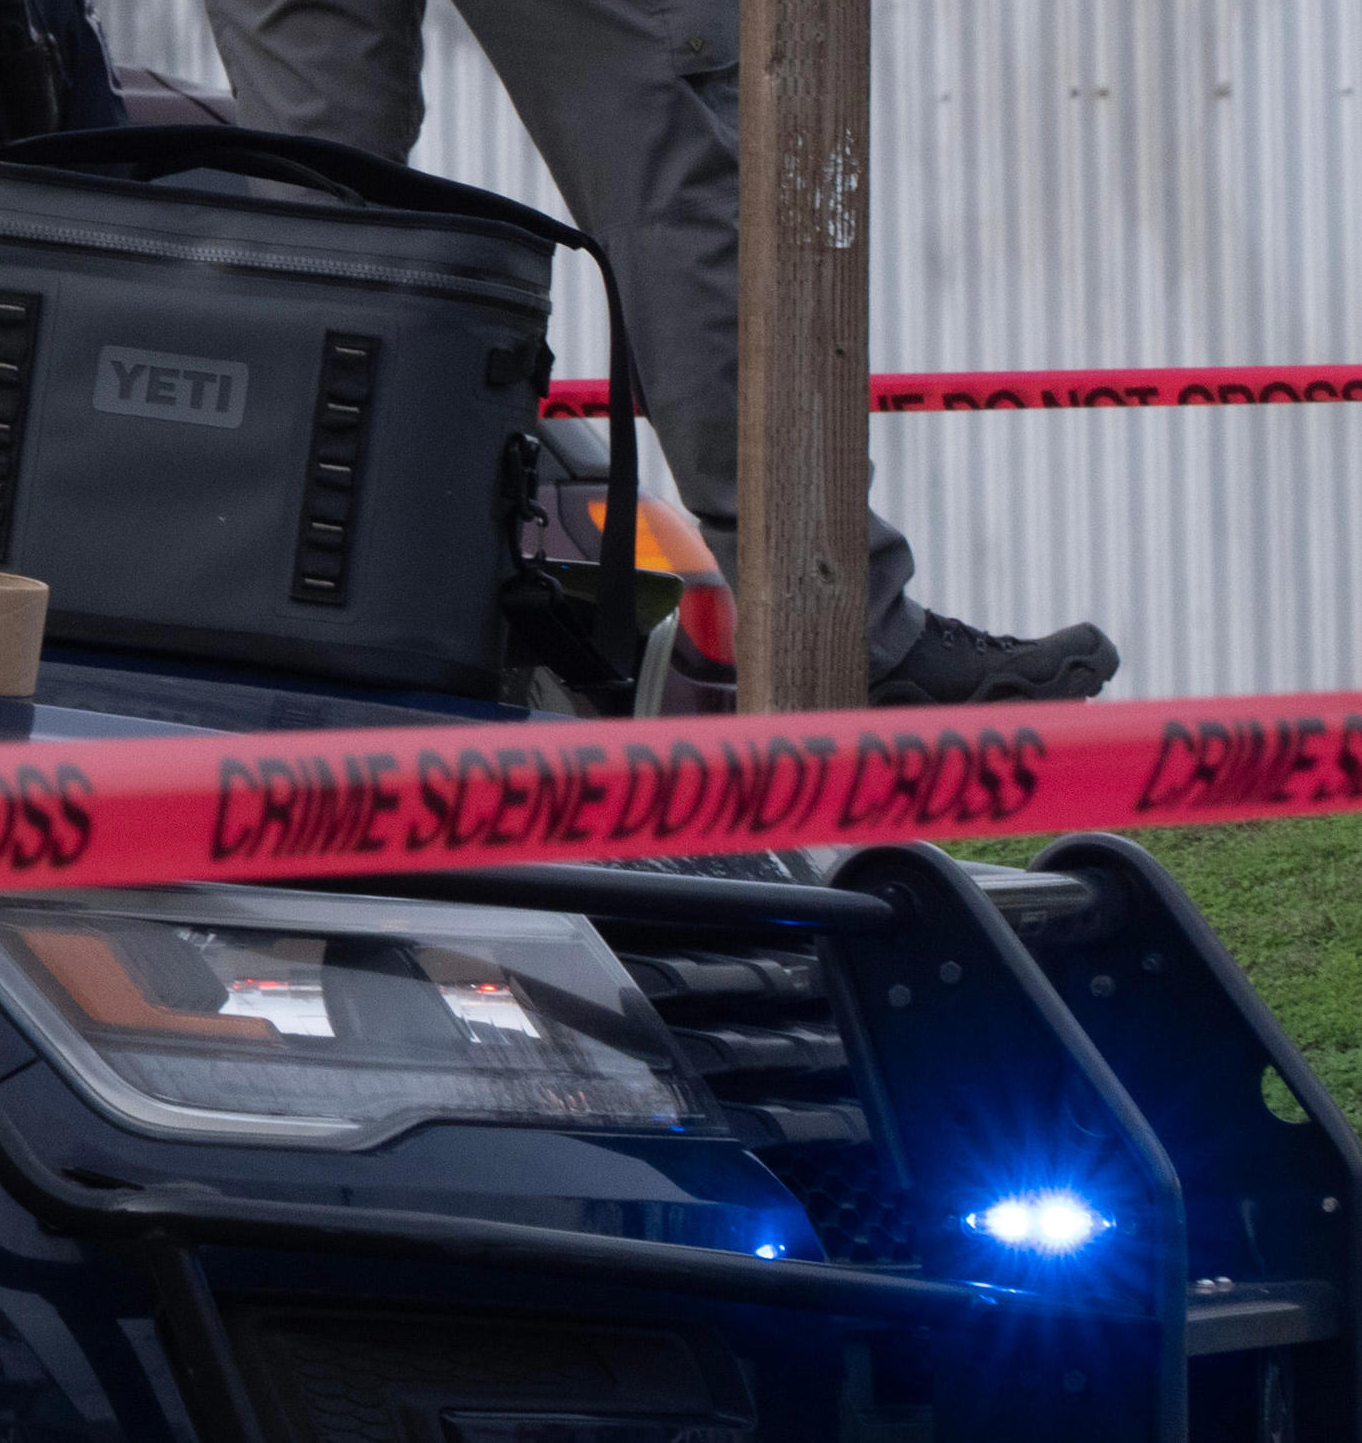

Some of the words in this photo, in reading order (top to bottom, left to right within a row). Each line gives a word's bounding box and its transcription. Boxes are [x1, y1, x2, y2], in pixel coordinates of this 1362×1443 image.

[110, 360, 232, 413] YETI
[208, 752, 400, 864] CRIME
[404, 743, 608, 853] SCENE
[606, 738, 709, 840] DO
[702, 733, 837, 836] NOT
[837, 725, 1048, 830] CROSS
[1133, 716, 1327, 814] CRIME
